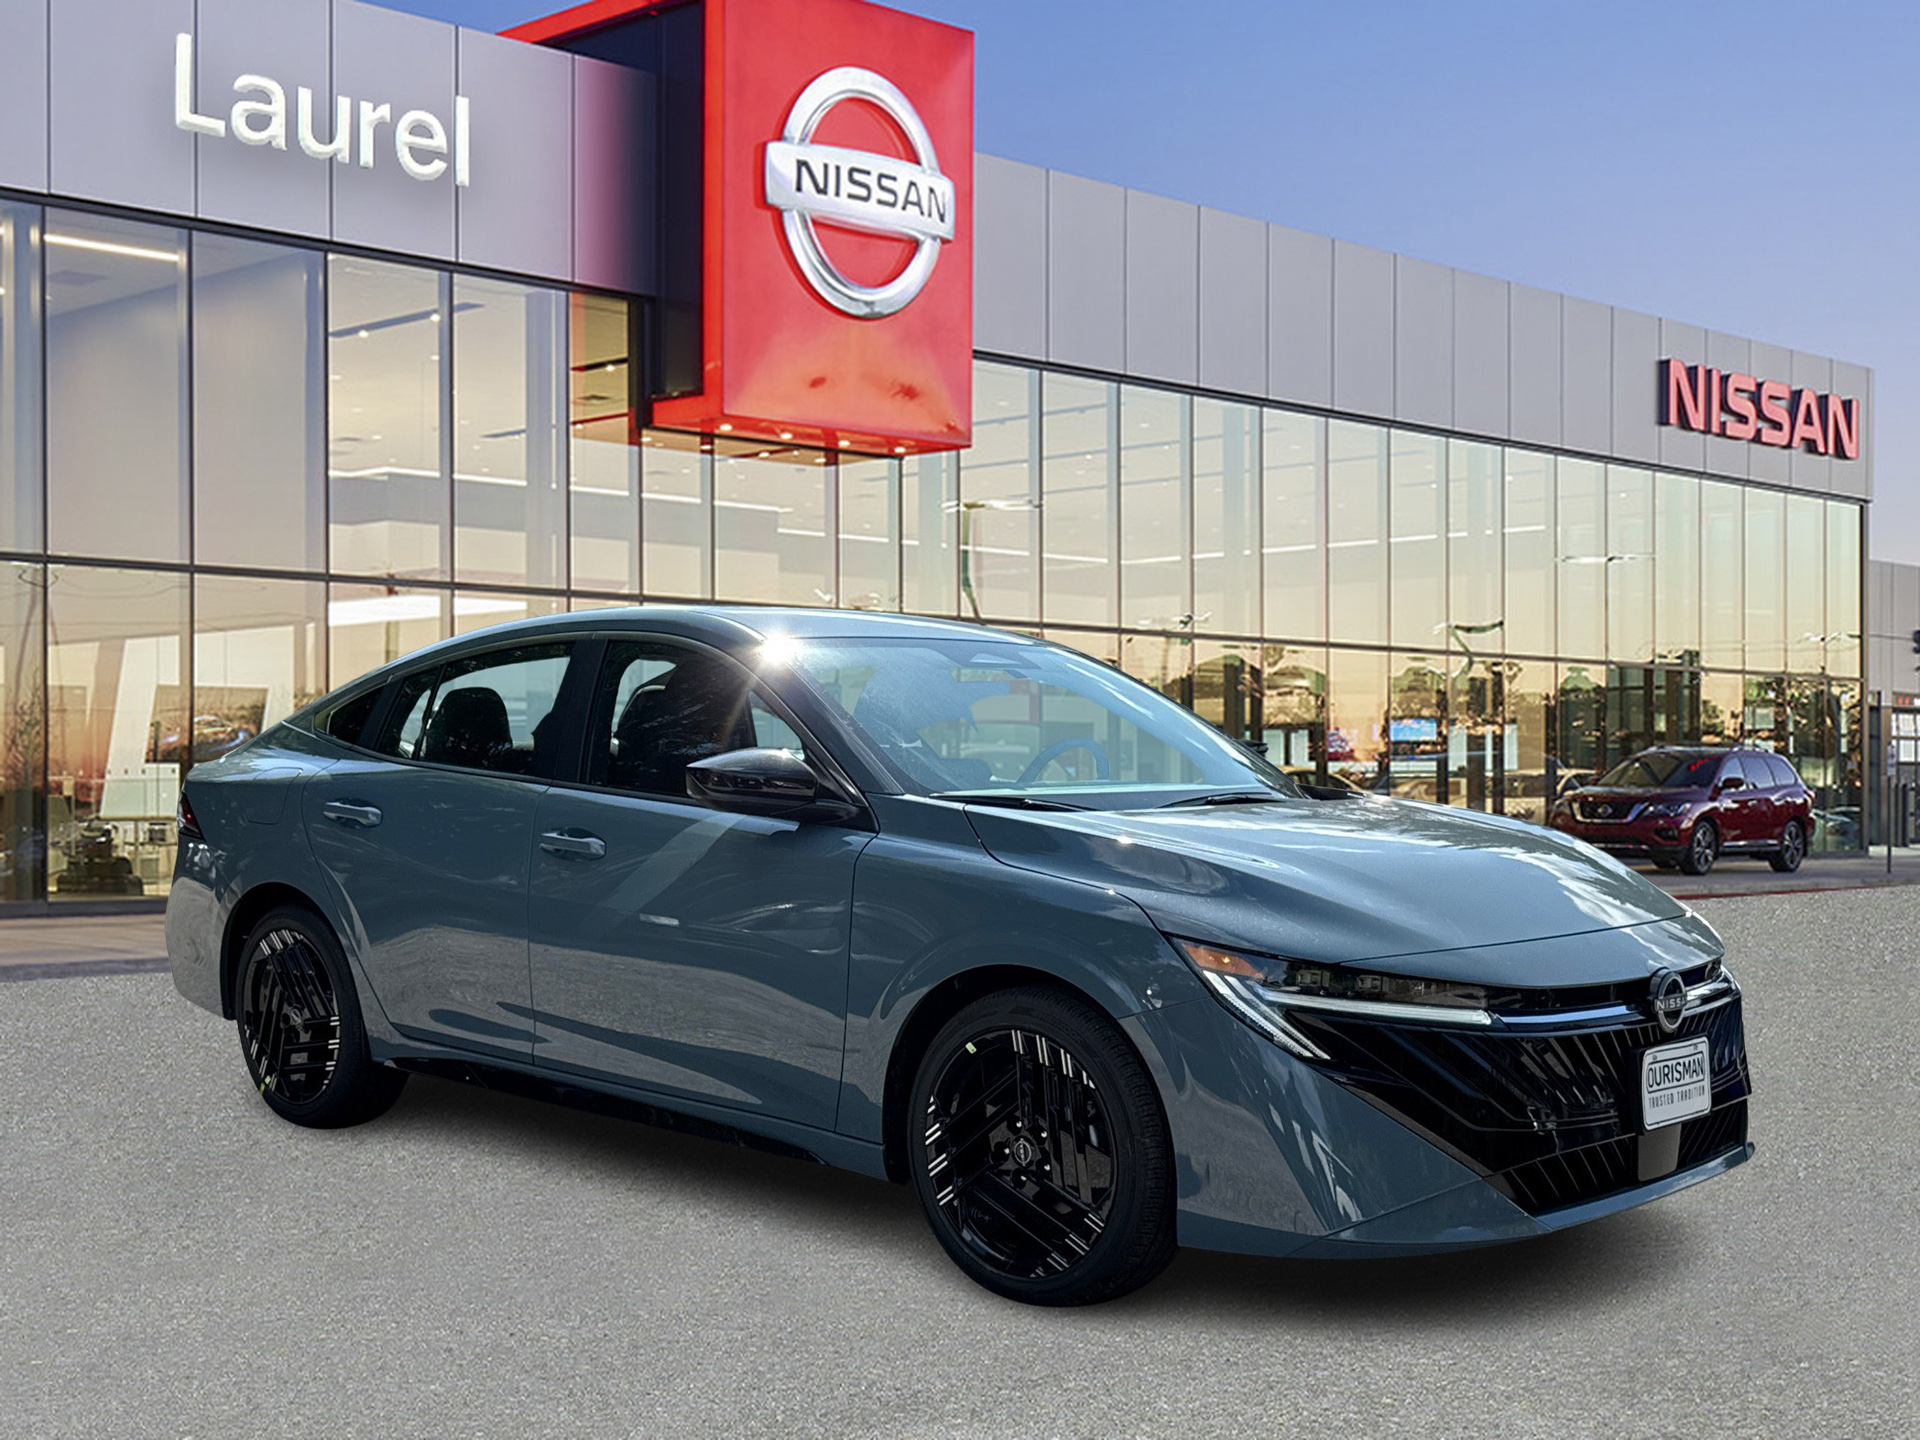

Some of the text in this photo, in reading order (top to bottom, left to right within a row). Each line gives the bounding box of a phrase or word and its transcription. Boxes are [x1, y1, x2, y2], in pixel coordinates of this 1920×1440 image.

[174, 32, 471, 188] Laurel
[795, 159, 947, 224] NISSAN
[1662, 358, 1860, 460] NISSAN
[1647, 1056, 1705, 1089] OURISMAN
[1648, 1092, 1675, 1109] TRUSTED
